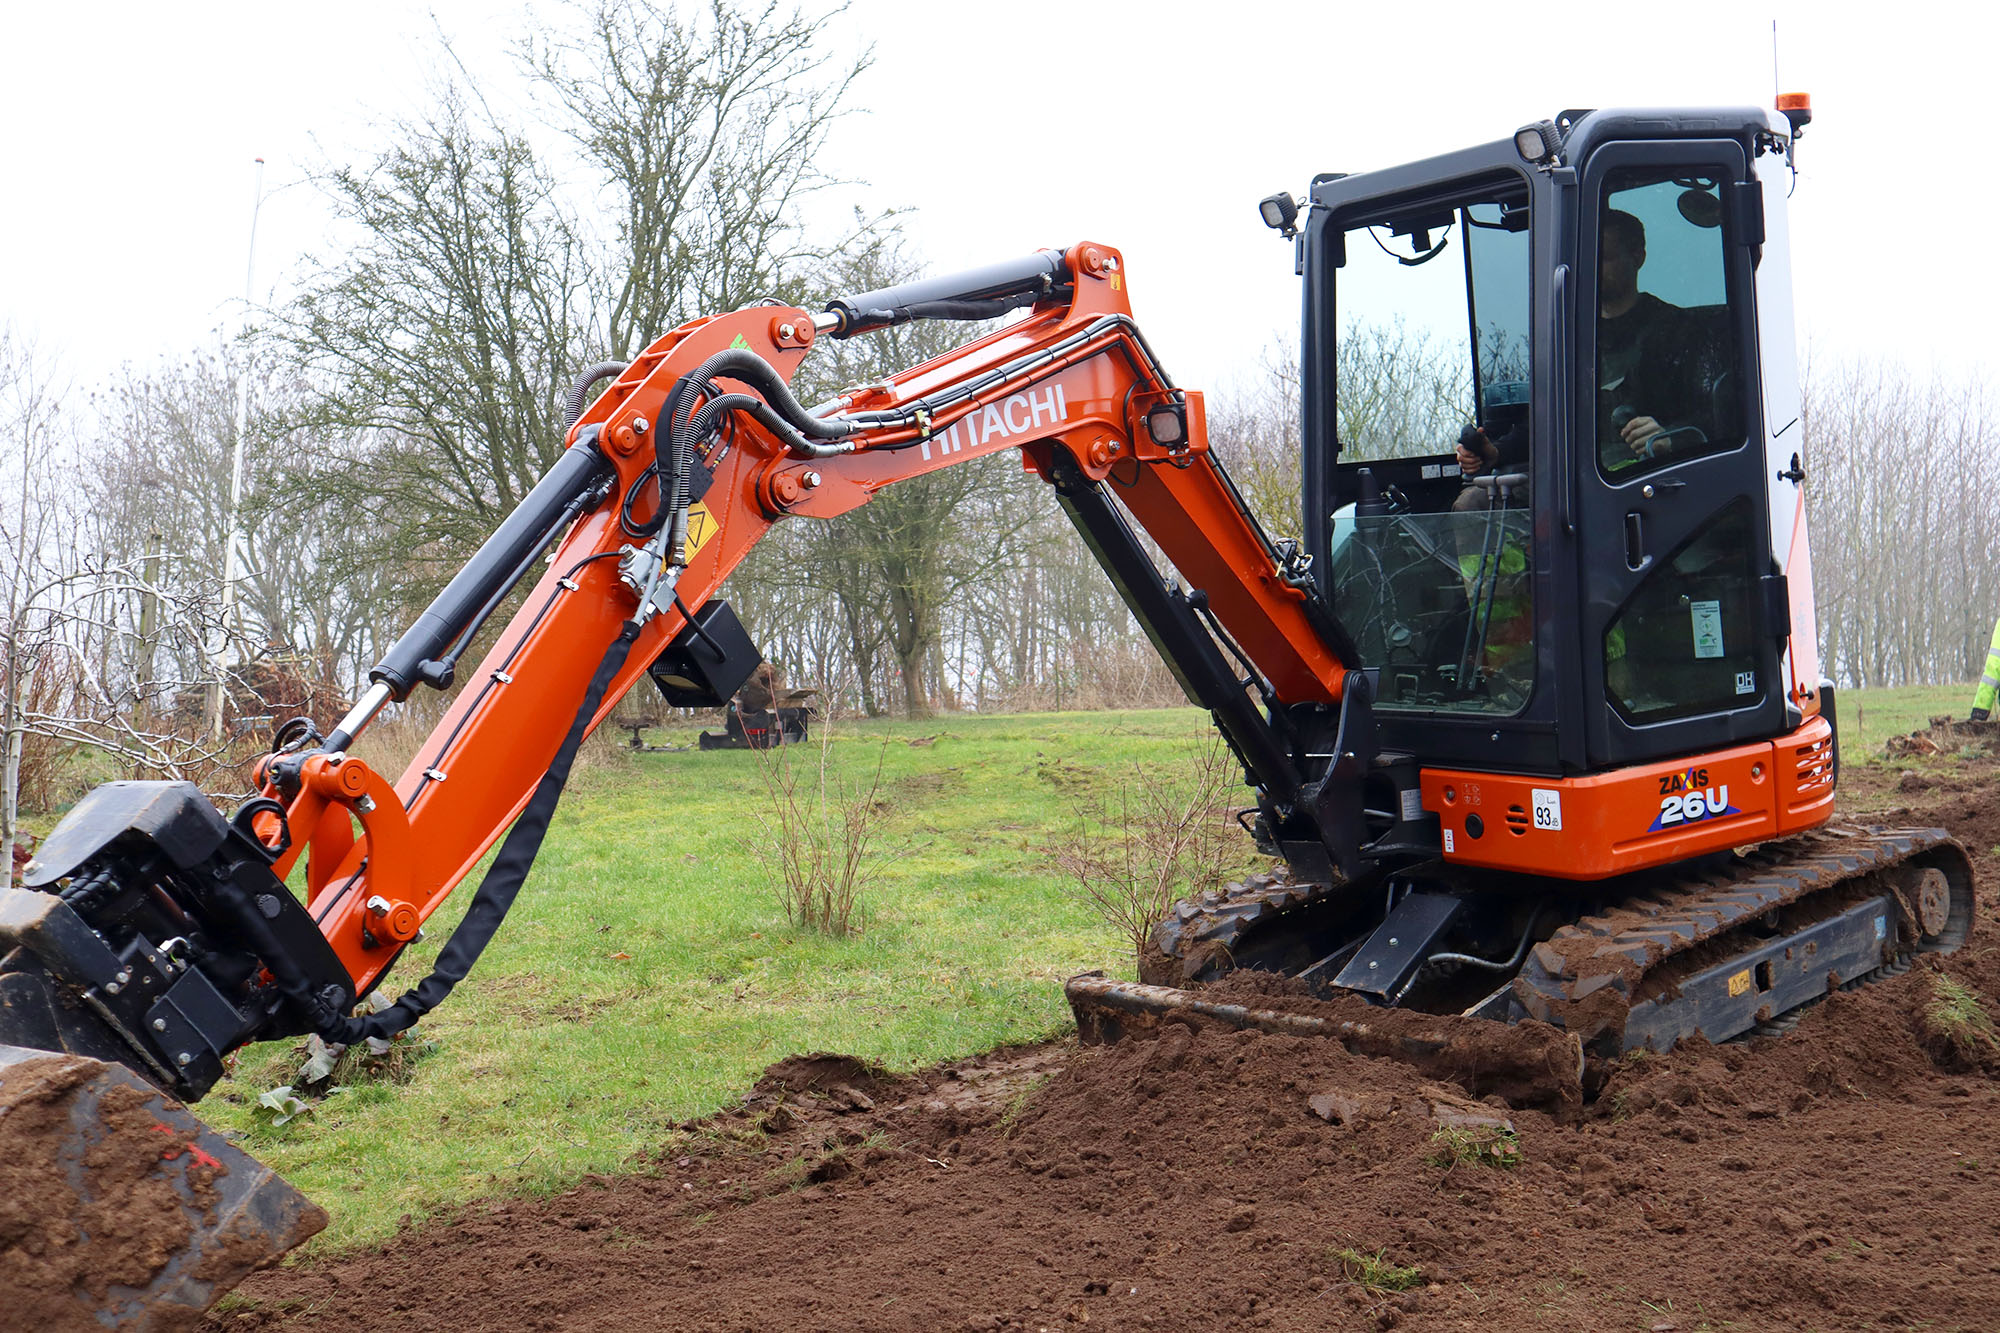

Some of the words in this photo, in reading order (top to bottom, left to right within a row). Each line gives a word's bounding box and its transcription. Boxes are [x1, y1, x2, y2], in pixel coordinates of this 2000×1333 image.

[920, 384, 1068, 461] HITACHI
[1659, 767, 1709, 795] ZAXIS
[1536, 806, 1551, 826] 93
[1660, 784, 1729, 827] 26U
